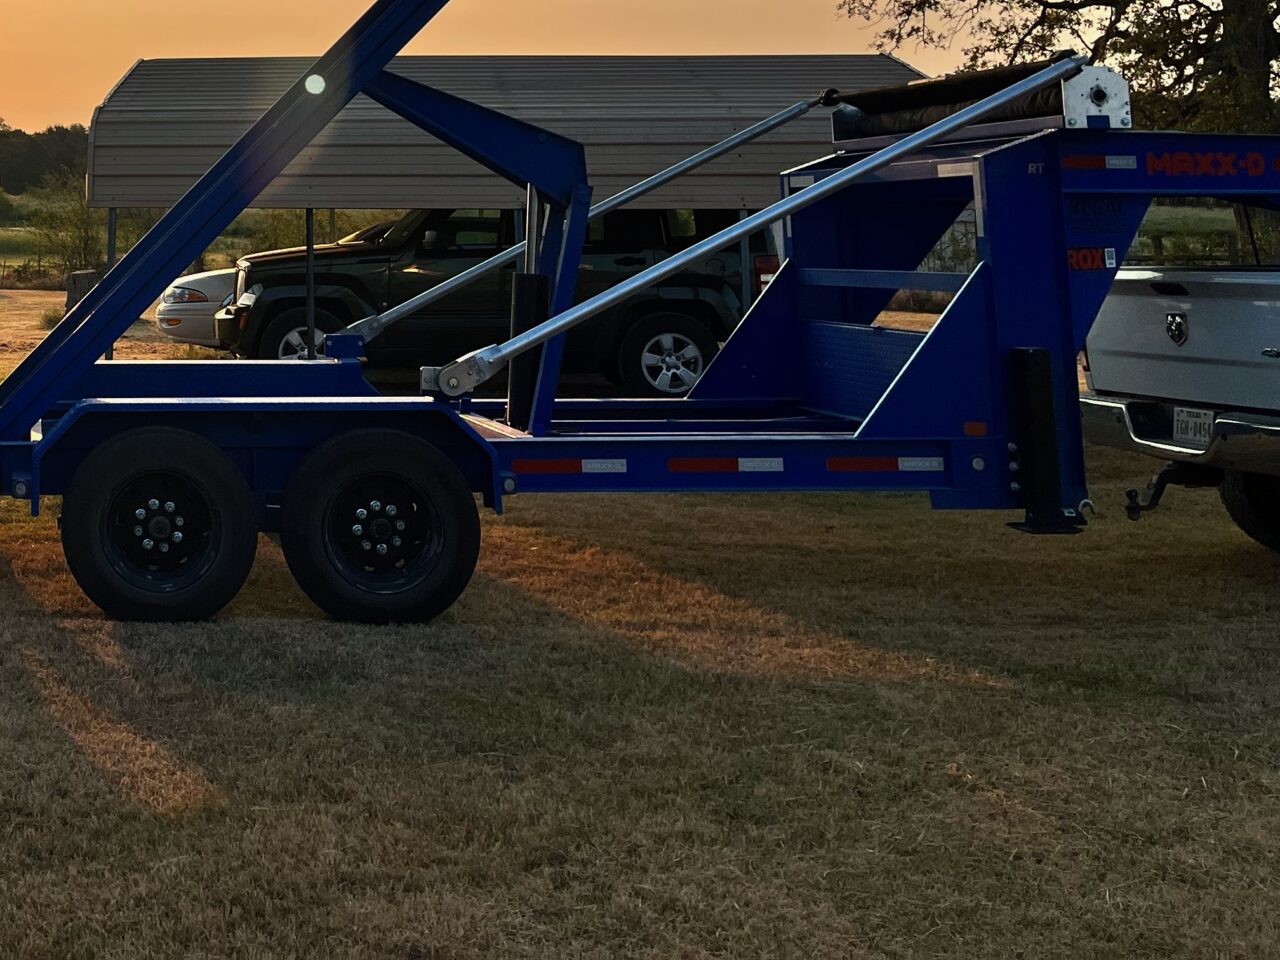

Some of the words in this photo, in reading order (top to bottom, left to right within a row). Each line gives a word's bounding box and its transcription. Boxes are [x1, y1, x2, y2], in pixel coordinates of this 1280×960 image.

[1028, 162, 1045, 175] RT
[1144, 151, 1265, 177] MAXX-D
[1068, 248, 1105, 271] ROX
[1186, 410, 1202, 419] TEXAS
